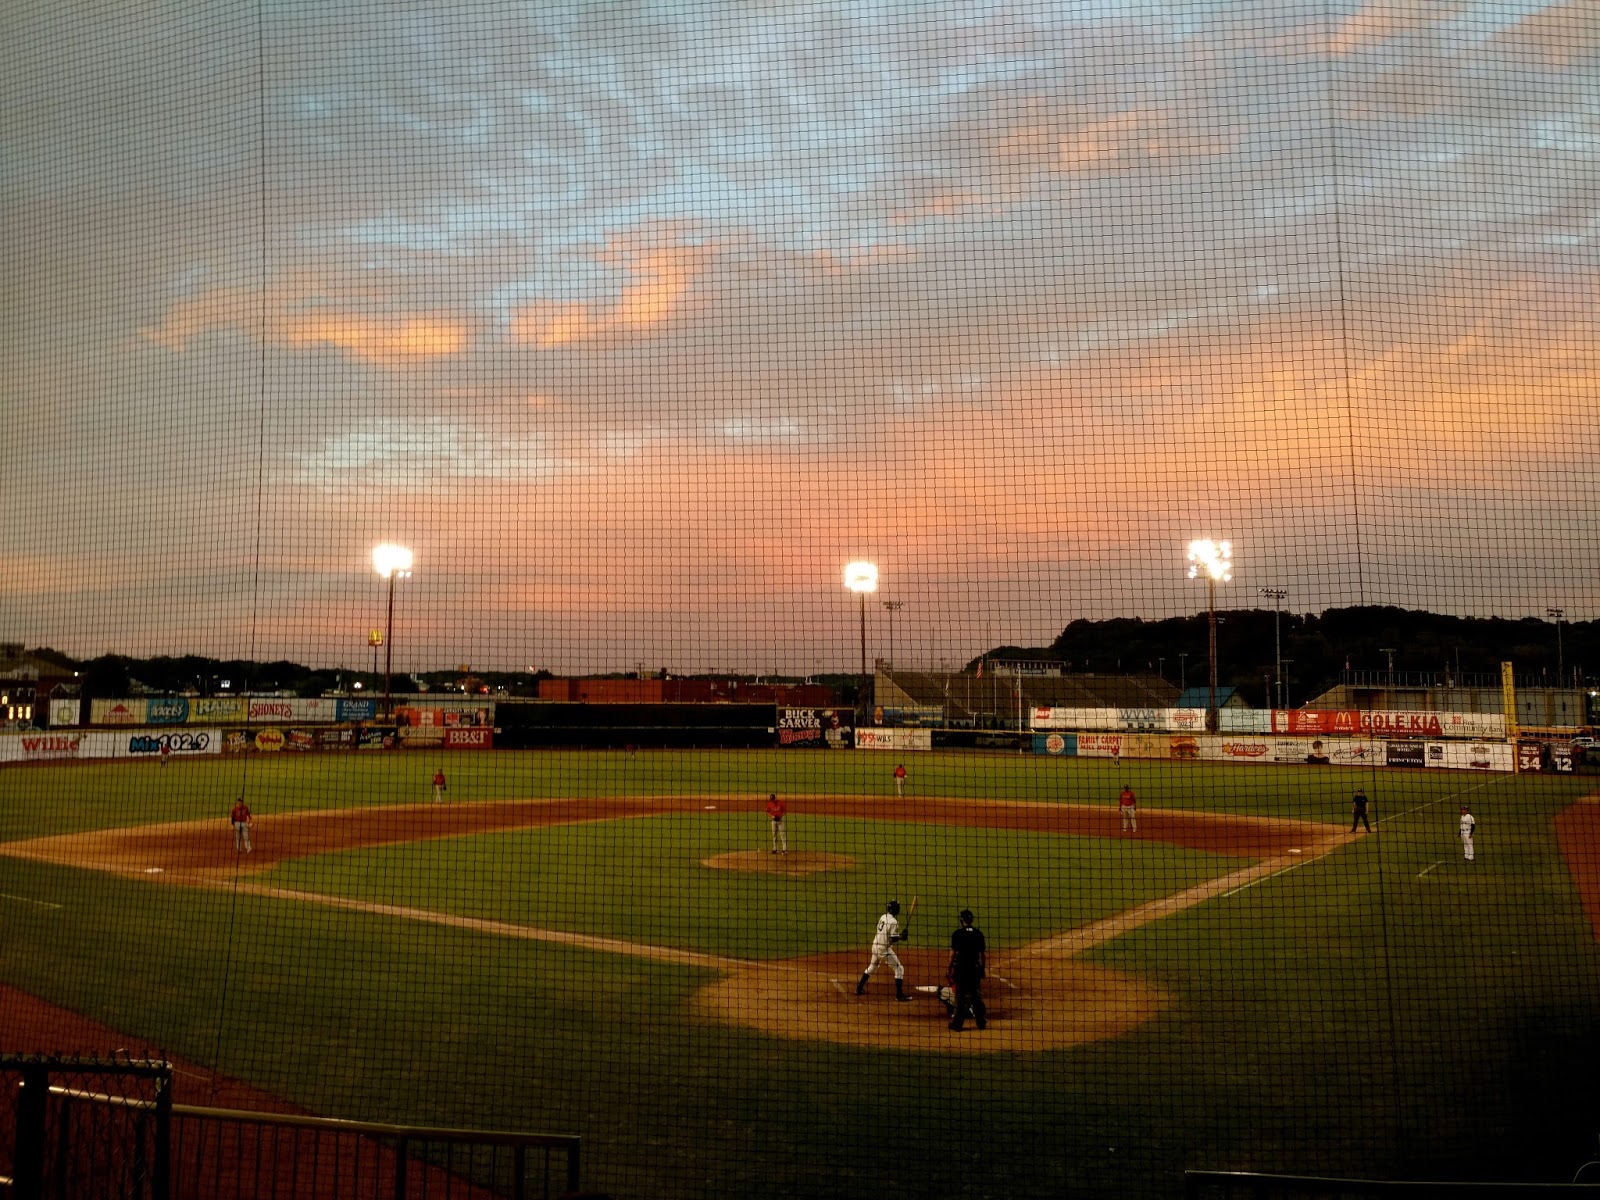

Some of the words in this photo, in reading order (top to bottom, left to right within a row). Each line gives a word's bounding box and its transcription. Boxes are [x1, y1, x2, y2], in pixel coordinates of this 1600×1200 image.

[249, 703, 292, 718] SHONEY'S
[785, 709, 815, 719] BUCK
[779, 718, 821, 728] SARVER
[1361, 713, 1406, 729] COLE
[1410, 714, 1442, 730] KIA
[1443, 724, 1487, 735] Community
[129, 736, 160, 753] Mix
[158, 733, 209, 751] 102.9
[449, 730, 488, 744] BB&T
[1078, 735, 1099, 745] FAMILY
[1101, 735, 1123, 746] CARPET
[1520, 757, 1541, 770] 34
[1554, 757, 1573, 771] 12
